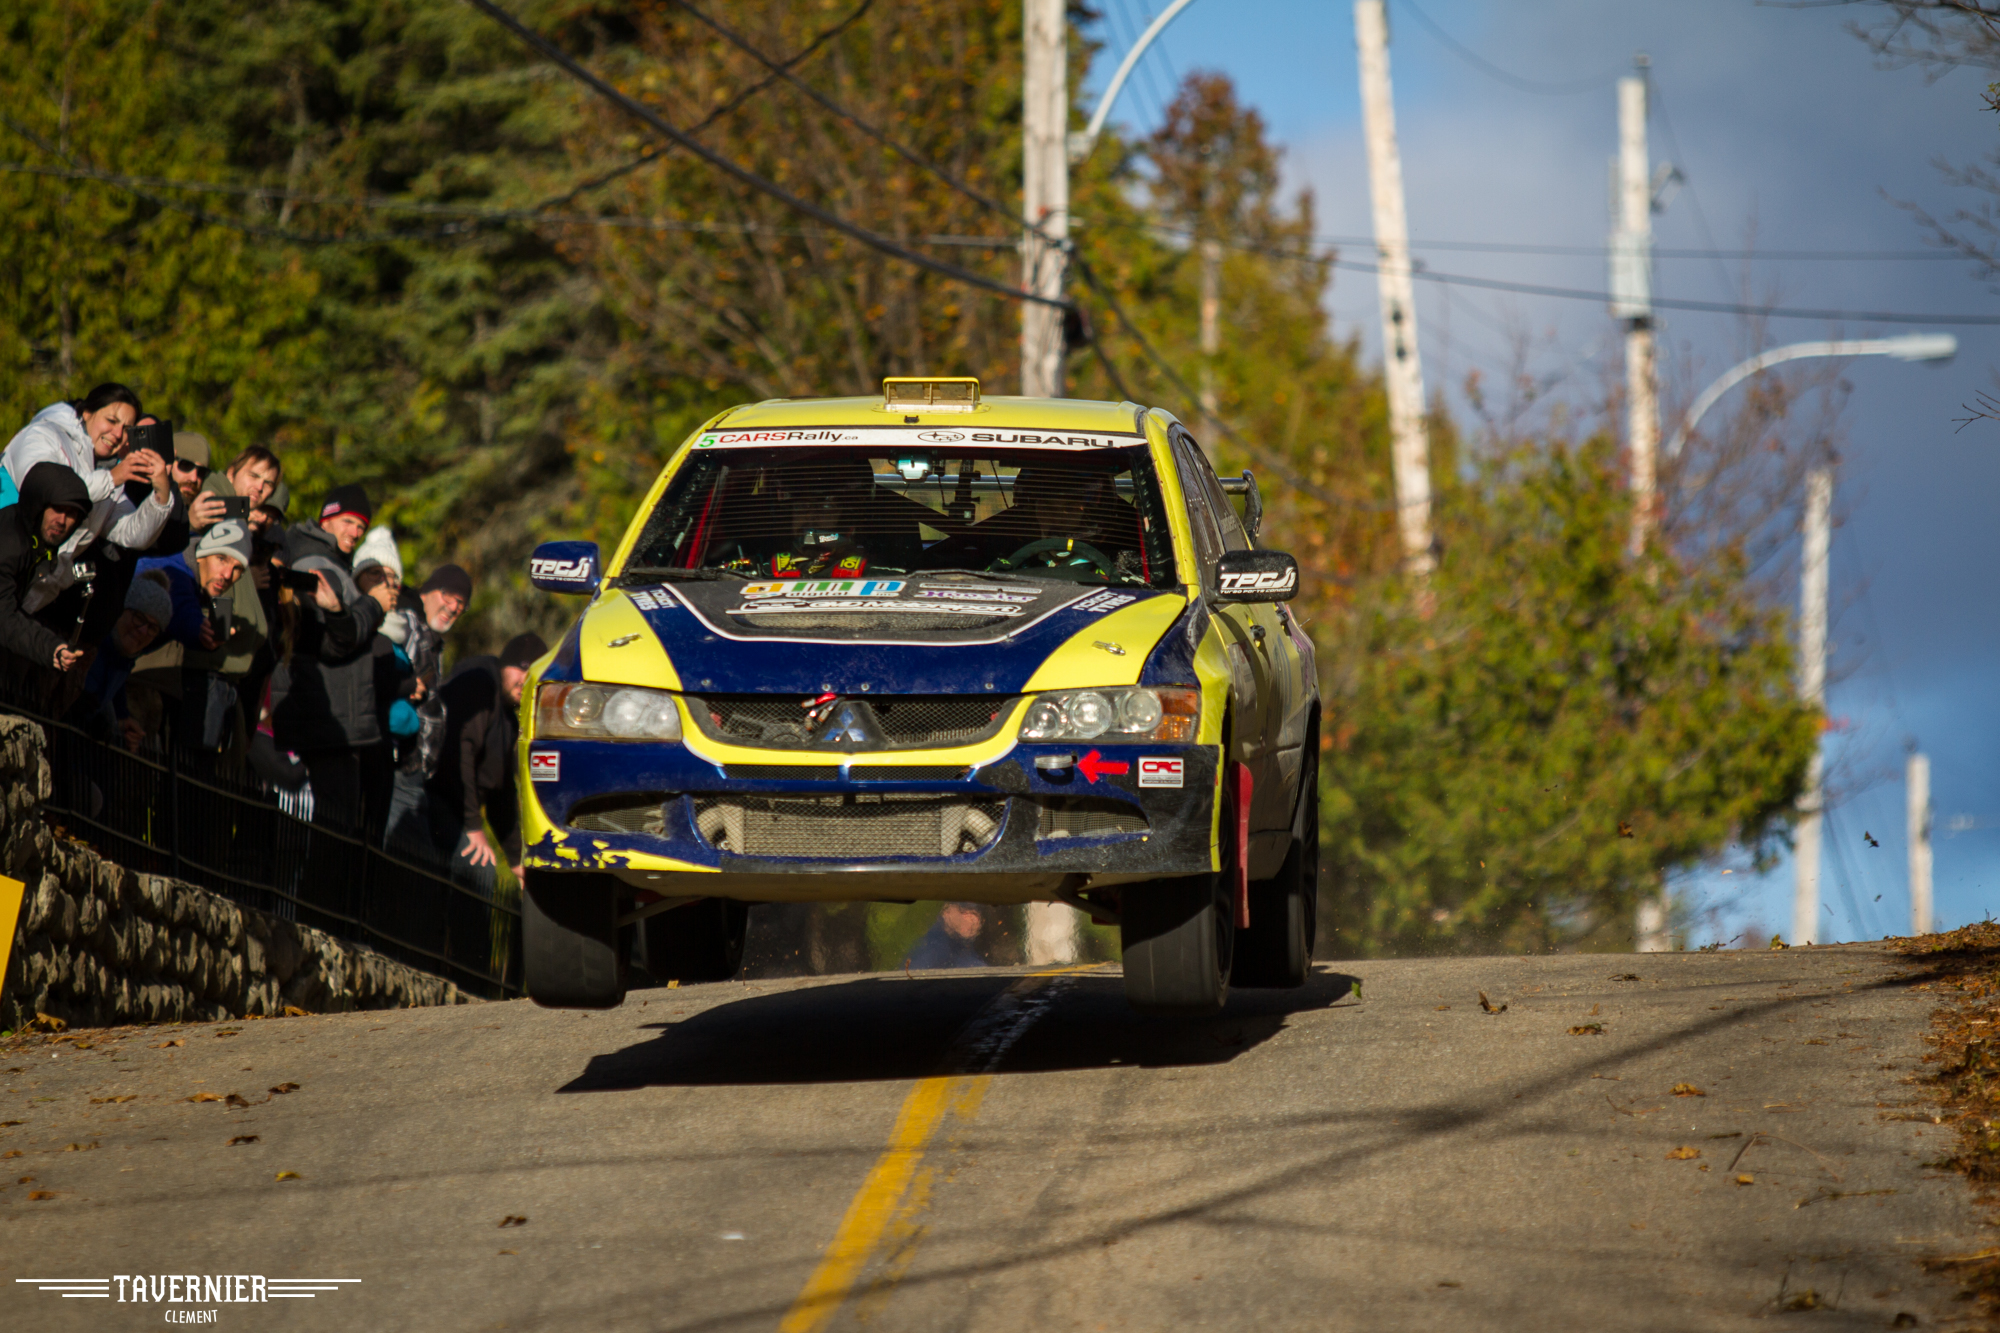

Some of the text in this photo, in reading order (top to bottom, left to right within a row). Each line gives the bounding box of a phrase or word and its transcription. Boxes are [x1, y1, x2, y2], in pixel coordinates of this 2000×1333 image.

[971, 433, 1114, 448] SUBARU
[530, 558, 574, 576] TPC
[1220, 573, 1279, 588] TPC
